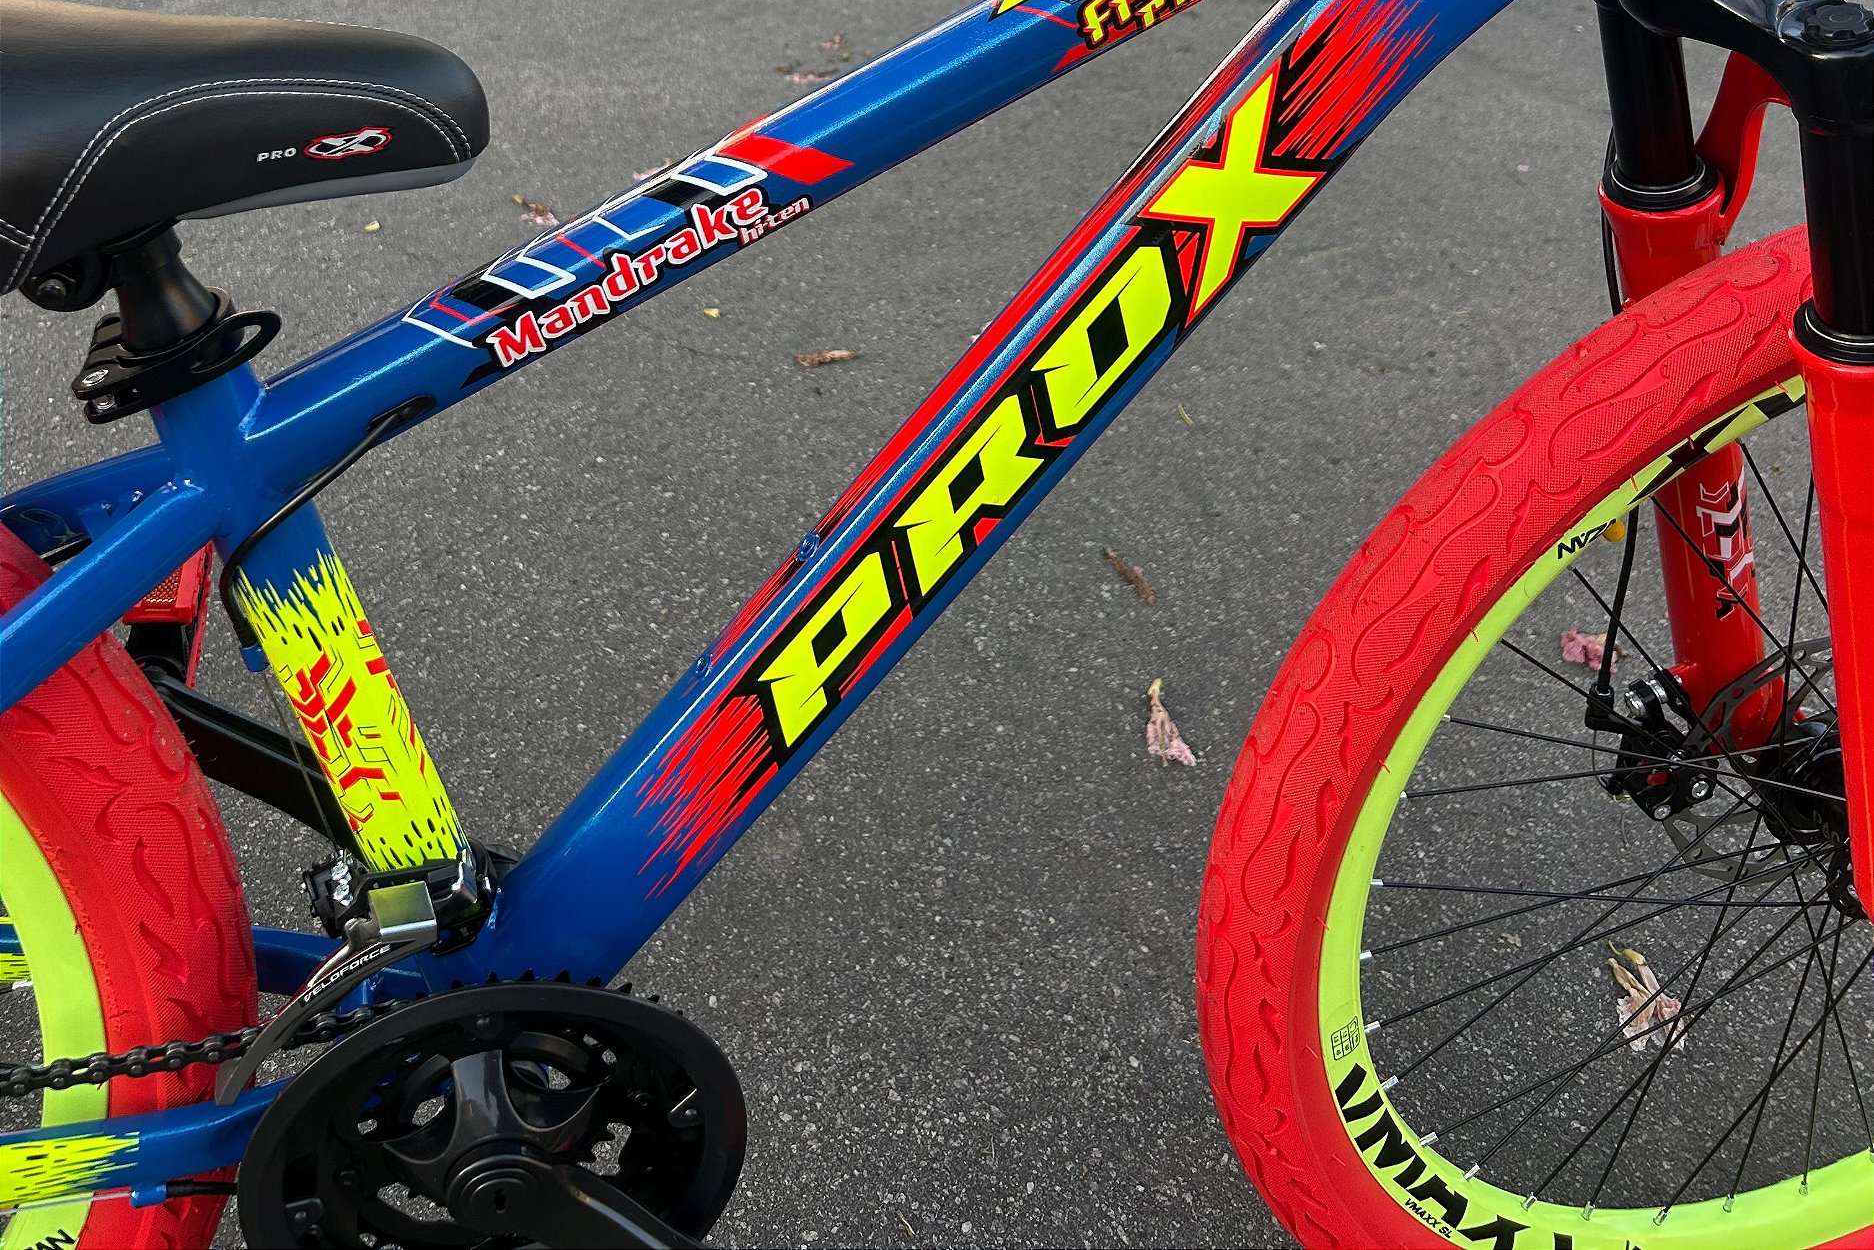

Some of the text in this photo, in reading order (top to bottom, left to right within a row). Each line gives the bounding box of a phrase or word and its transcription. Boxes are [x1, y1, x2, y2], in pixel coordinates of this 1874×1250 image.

[256, 148, 297, 162] PRO
[486, 187, 770, 368] Mandrake
[757, 68, 1325, 748] PROX
[303, 943, 392, 1003] VELOFORCE
[1404, 1197, 1453, 1239] VMAXX SL
